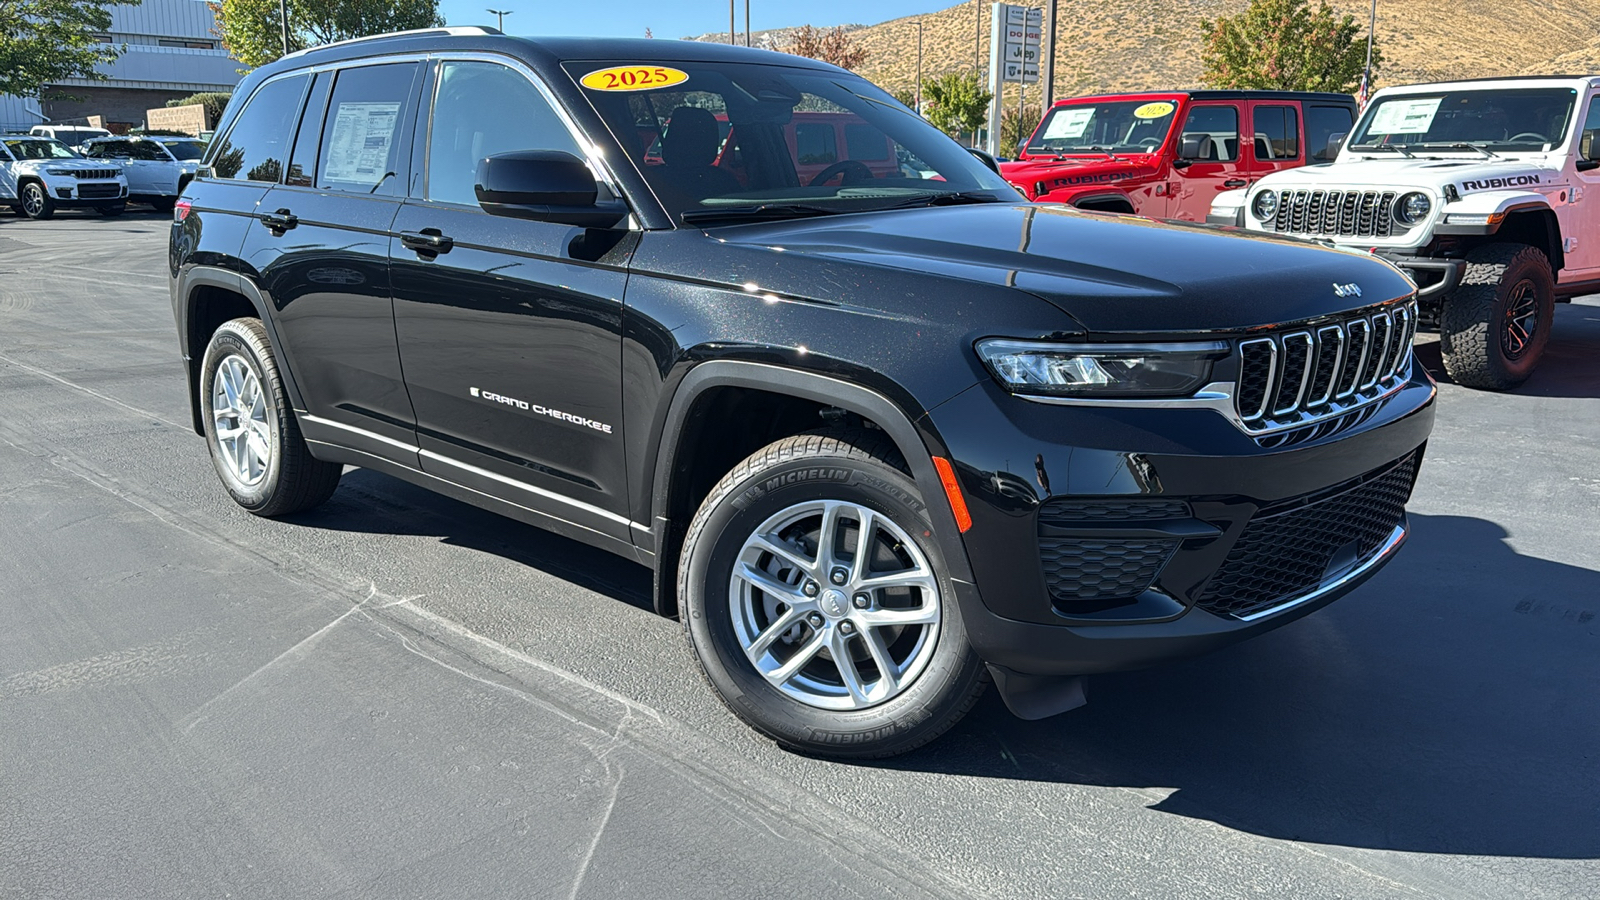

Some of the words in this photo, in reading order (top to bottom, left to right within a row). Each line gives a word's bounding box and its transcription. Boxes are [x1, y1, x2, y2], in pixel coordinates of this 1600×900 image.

[1010, 31, 1040, 39] DOGE
[602, 68, 668, 88] 2025
[1054, 172, 1134, 186] RUBICON
[1462, 174, 1541, 191] RUBICON
[1332, 282, 1362, 298] Jeep
[482, 390, 530, 410] GRAND
[532, 404, 613, 434] CHEROKEE
[766, 468, 848, 492] MICHELIN
[814, 725, 895, 744] MICHELIN
